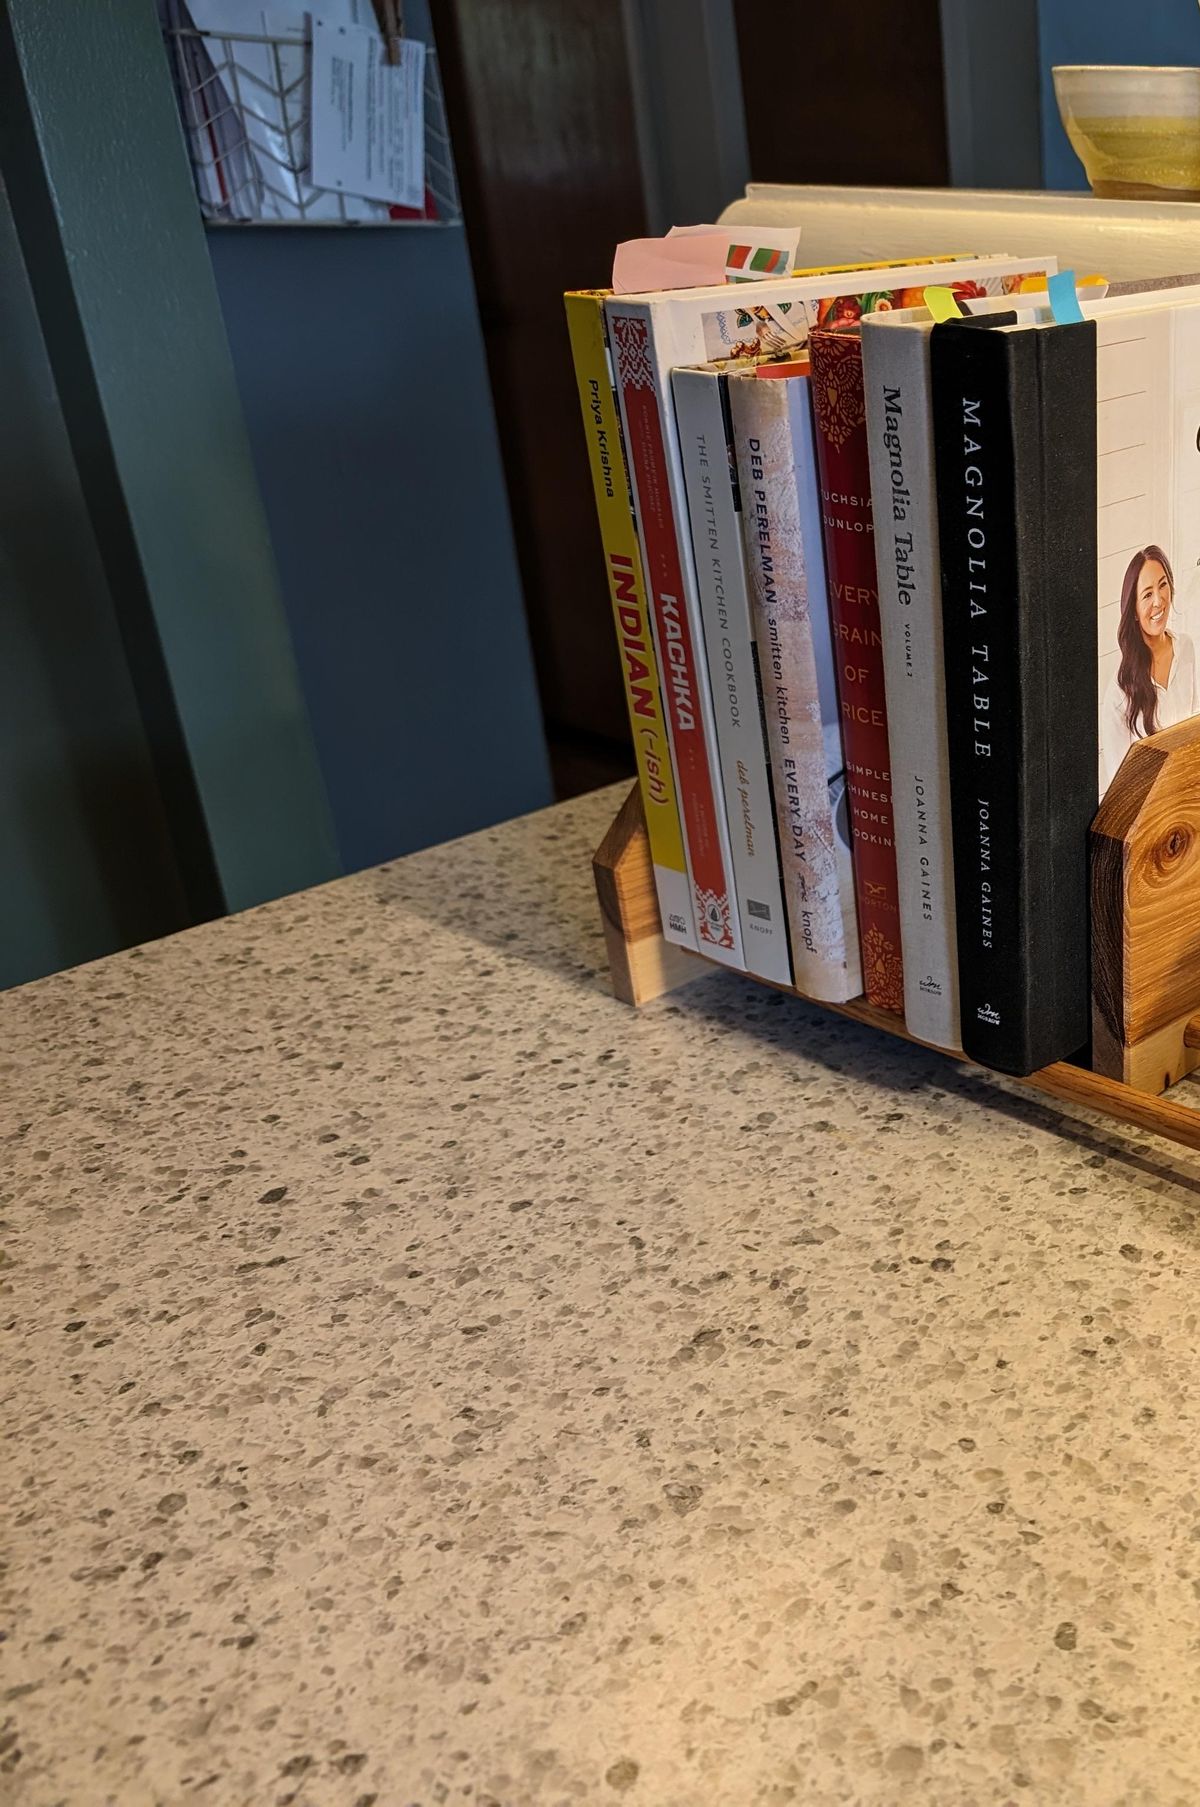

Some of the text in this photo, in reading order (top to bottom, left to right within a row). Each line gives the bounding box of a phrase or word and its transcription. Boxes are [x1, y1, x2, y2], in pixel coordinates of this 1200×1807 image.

[588, 379, 614, 498] Priya Krishna
[883, 385, 917, 606] Magnolia Table
[749, 438, 777, 603] DEB PERELMAN
[963, 398, 991, 757] MAGNOLIA TABLE
[696, 435, 741, 728] THE SMITTEN KITCHEN COOKBOOK
[609, 553, 669, 805] INDIAN (-ish)
[660, 592, 695, 731] KACHKA
[768, 618, 791, 745] smitten kitchen
[844, 665, 869, 684] OF
[904, 623, 913, 668] VOLUME
[842, 702, 884, 726] RICE
[846, 761, 891, 782] SIMPLE
[736, 760, 756, 857] deb perelman
[784, 759, 807, 862] EVERY DAY
[854, 806, 889, 825] HOME
[914, 775, 933, 921] JOANNA GAINES
[750, 922, 773, 935] KNOPF
[801, 910, 817, 955] knopf
[977, 798, 993, 948] JOANNA GAINES
